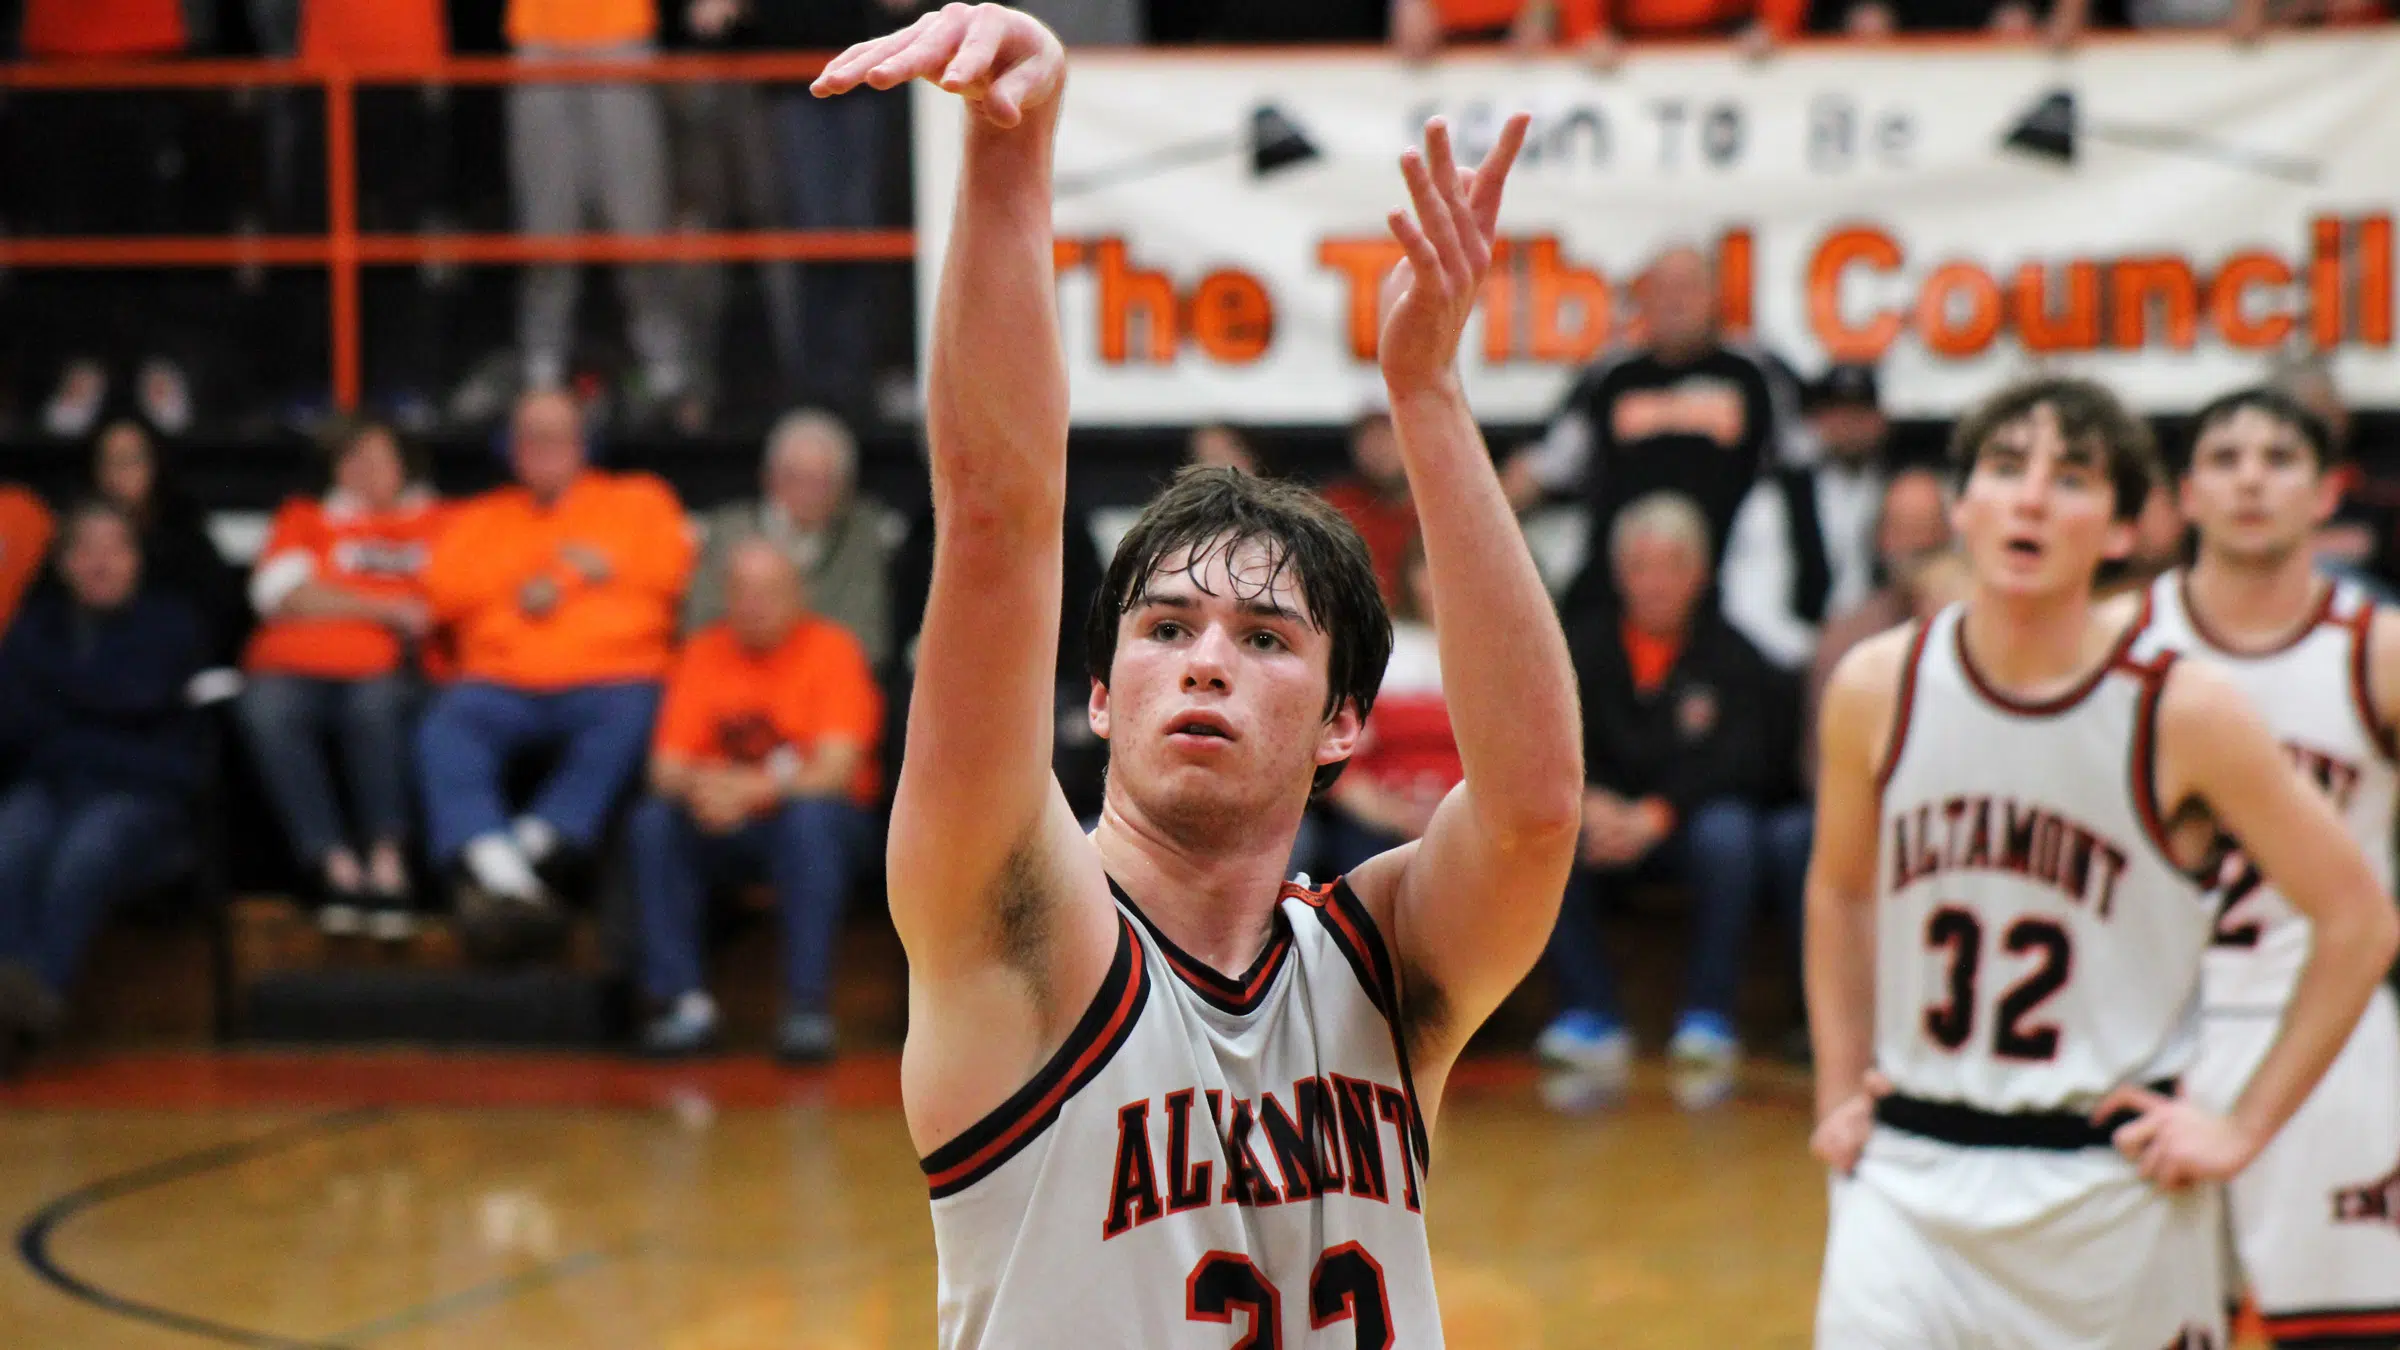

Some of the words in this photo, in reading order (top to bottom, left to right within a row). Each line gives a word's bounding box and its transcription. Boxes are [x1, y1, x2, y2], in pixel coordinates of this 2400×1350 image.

[1318, 226, 1752, 364] Tibl
[1805, 211, 2393, 360] Council
[1891, 796, 2129, 919] ALTAMONT
[1922, 904, 2073, 1062] 32
[1103, 1072, 1422, 1241] ALAMONT
